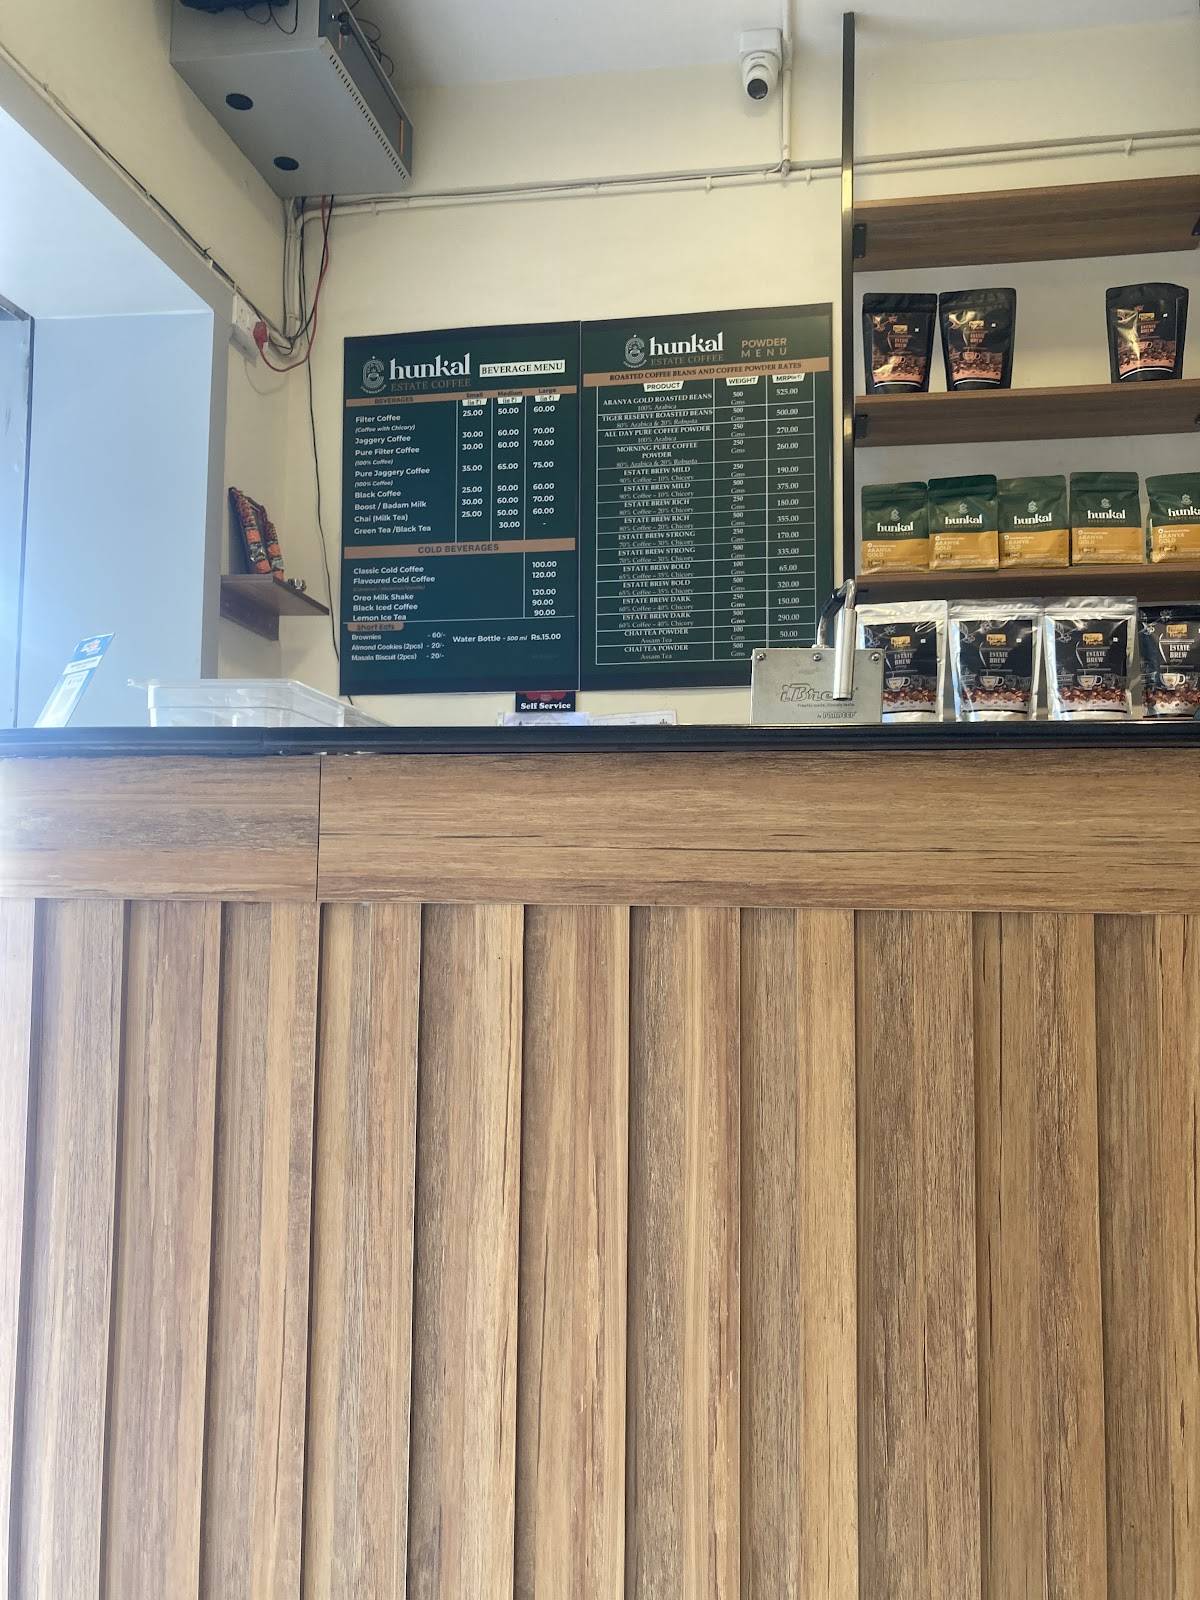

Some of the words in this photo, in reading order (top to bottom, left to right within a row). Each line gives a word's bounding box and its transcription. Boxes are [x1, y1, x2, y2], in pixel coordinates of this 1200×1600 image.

[650, 331, 724, 356] hunkal
[742, 338, 787, 348] POWDER
[741, 348, 787, 358] MENU
[651, 357, 686, 366] ESTATE
[688, 354, 724, 364] COFFEE
[389, 353, 471, 380] hunkal
[481, 365, 532, 374] BEVERAGE
[534, 362, 563, 371] MENU
[610, 372, 643, 381] ROASTED
[645, 370, 671, 378] COFFEE
[673, 369, 696, 377] BEANS
[716, 366, 742, 374] COFFEE
[744, 364, 776, 372] POWDER
[778, 362, 801, 370] RATES
[391, 381, 428, 392] ESTATE
[647, 382, 681, 390] PRODUCT
[729, 377, 756, 385] WEIGHT
[654, 395, 687, 403] ROASTED
[688, 409, 712, 417] BEANS
[776, 408, 798, 416] 500.00
[680, 425, 710, 433] POWDER
[355, 437, 384, 445] Jaggery
[650, 443, 670, 451] PURE
[671, 442, 698, 450] COFFEE
[355, 470, 372, 478] Pure
[374, 469, 404, 478] Jaggery
[1088, 509, 1126, 519] hunkal
[1168, 506, 1200, 517] hunka
[373, 514, 390, 522] (Milk
[392, 513, 408, 521] Tea)
[945, 514, 982, 524] hunkal
[1014, 512, 1052, 524] hunkal
[877, 522, 914, 532] hunkal
[444, 544, 499, 553] BEVERAGES
[780, 630, 797, 638] 50.00
